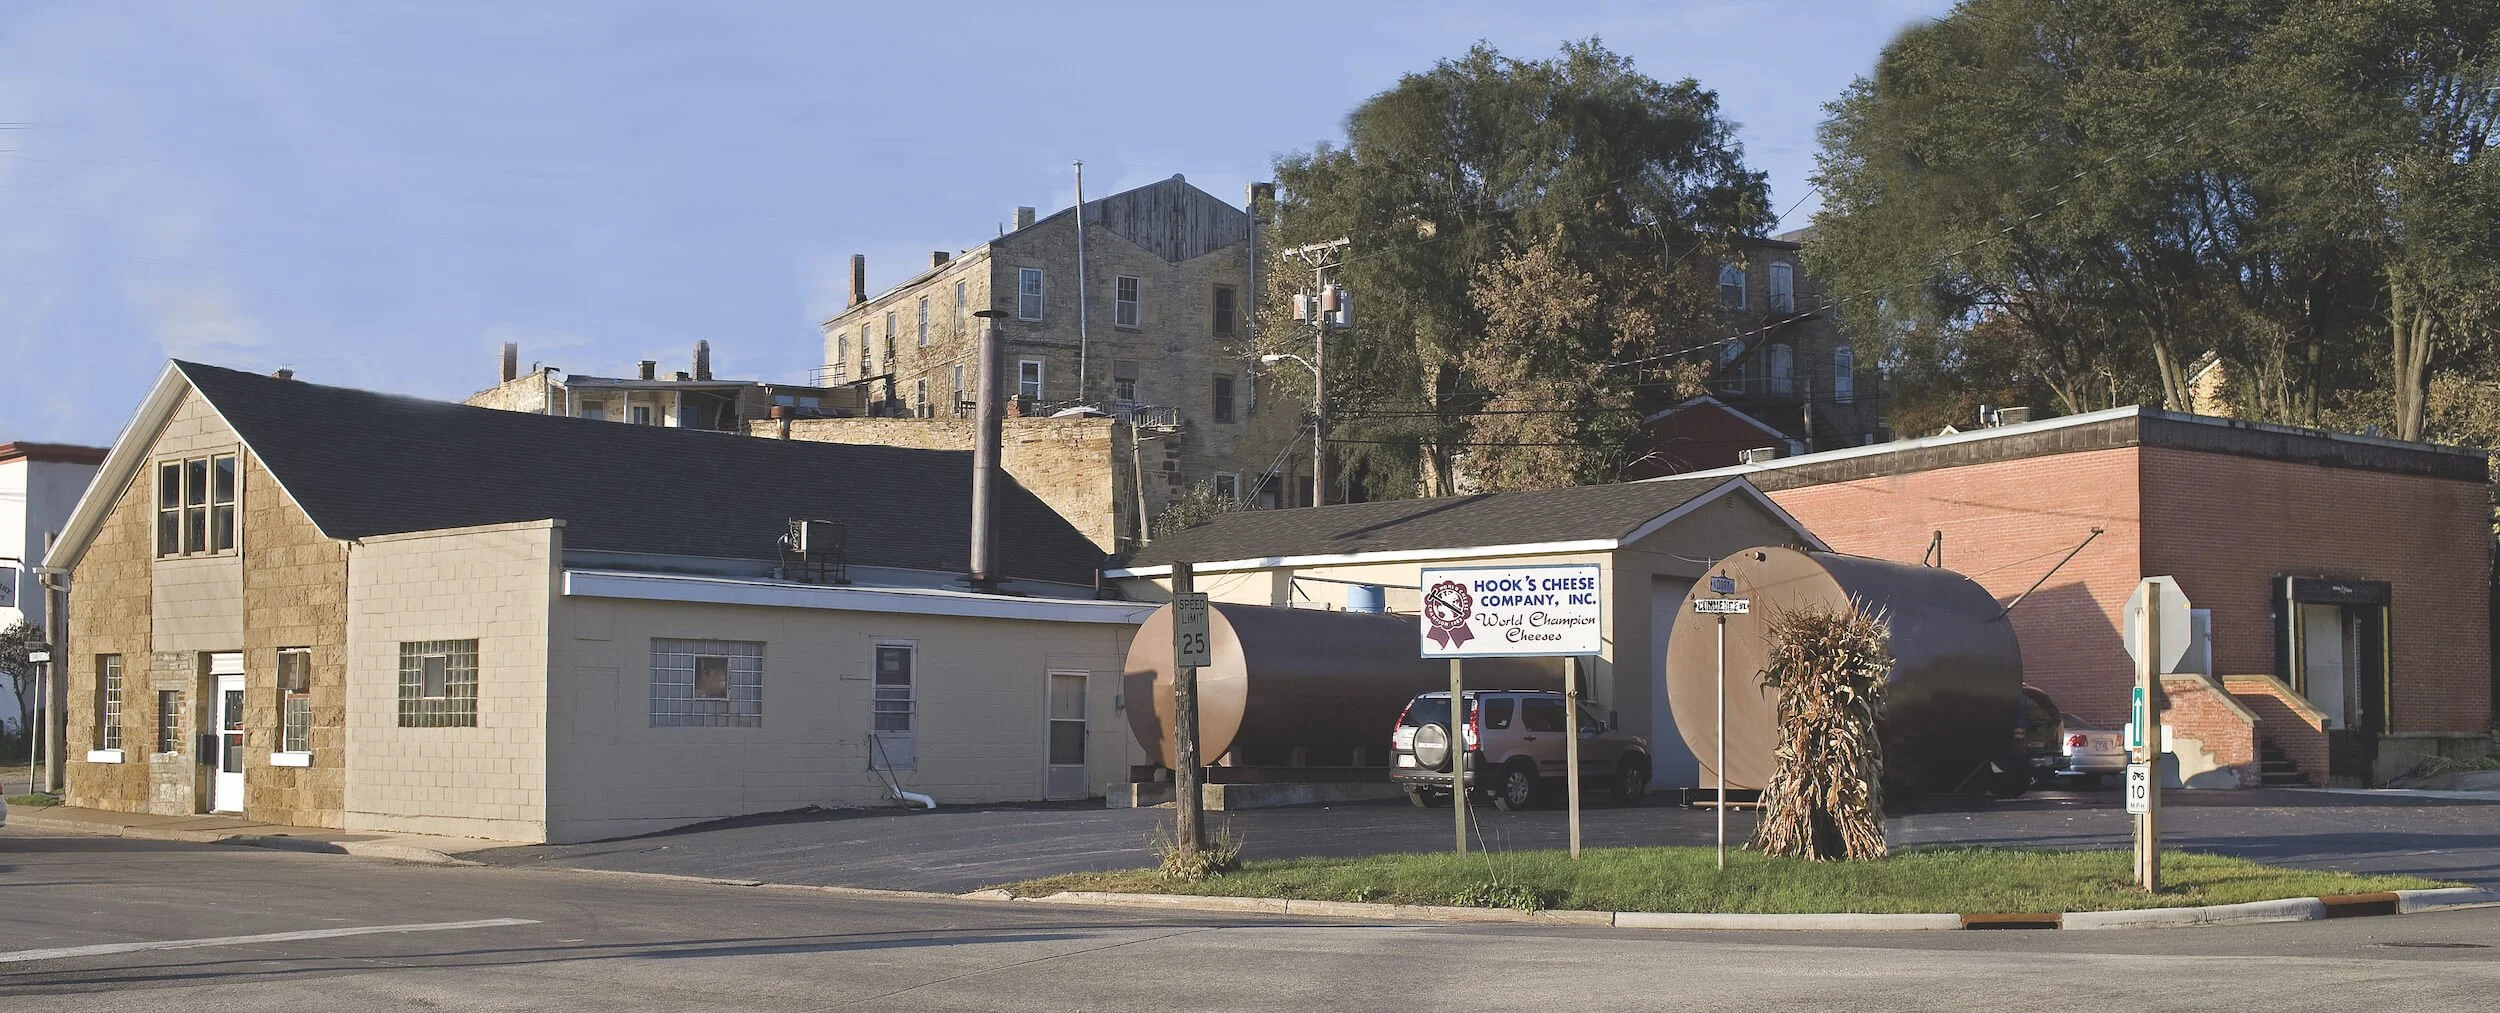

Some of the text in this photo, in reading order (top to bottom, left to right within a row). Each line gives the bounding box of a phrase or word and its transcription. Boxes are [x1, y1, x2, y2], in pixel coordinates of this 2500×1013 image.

[1474, 575, 1594, 592] HOOK'S CHEESE
[1179, 600, 1205, 610] SPEED
[1480, 592, 1597, 607] COMPANY, INC.
[1181, 613, 1204, 625] LIMIT
[1475, 611, 1595, 628] World Champion
[1505, 627, 1562, 643] Cheeses
[1183, 632, 1205, 655] 25
[2132, 784, 2145, 799] 10
